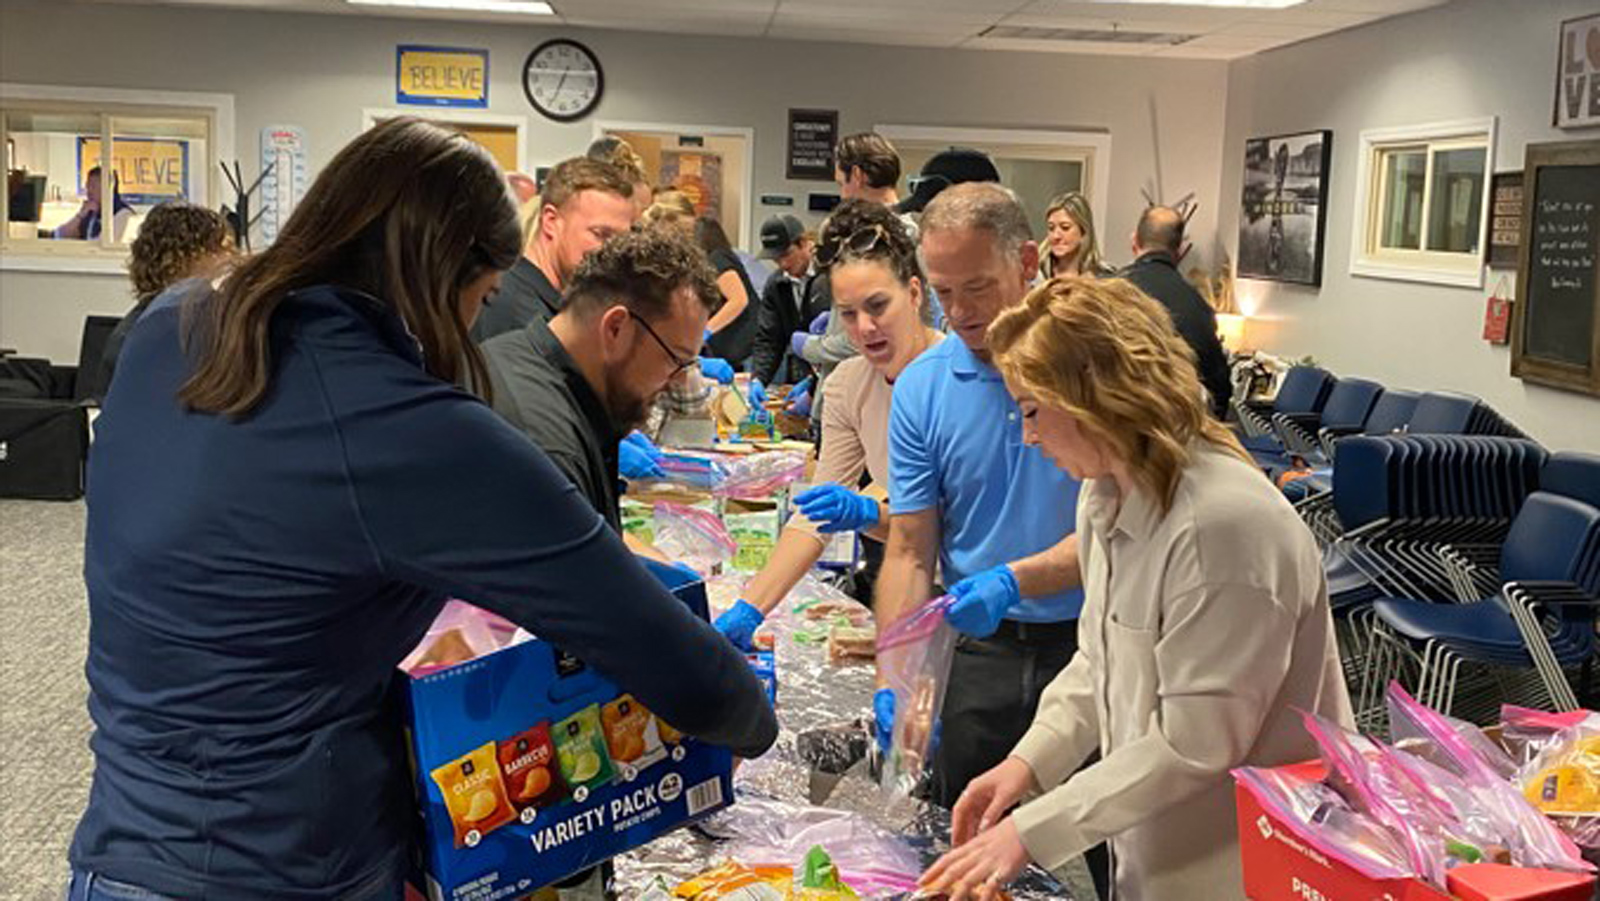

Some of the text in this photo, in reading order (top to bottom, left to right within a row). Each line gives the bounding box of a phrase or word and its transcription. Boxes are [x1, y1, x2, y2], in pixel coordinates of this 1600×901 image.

[409, 64, 482, 91] BELIEVE
[453, 768, 492, 796] CLASSIC
[660, 775, 679, 790] 42
[530, 783, 658, 855] VARIETY PACK
